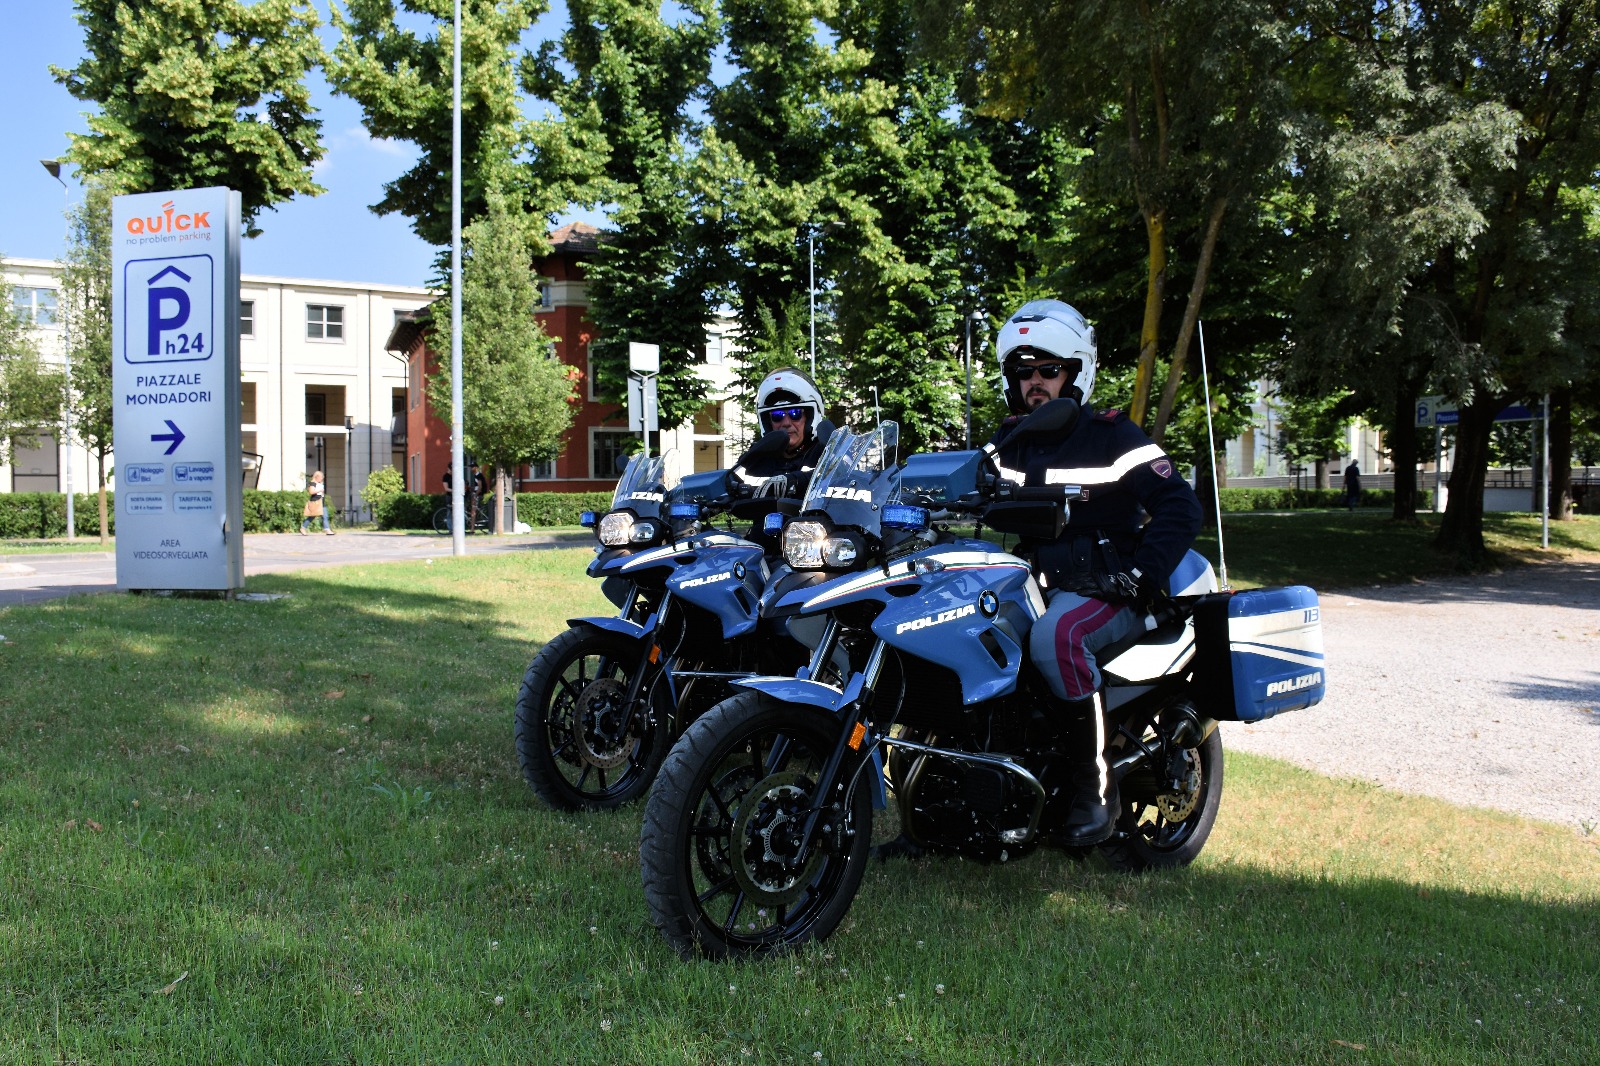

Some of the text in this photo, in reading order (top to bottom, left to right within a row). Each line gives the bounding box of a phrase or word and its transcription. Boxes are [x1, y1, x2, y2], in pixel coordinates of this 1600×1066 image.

[127, 200, 211, 234] QUICK
[140, 234, 176, 246] problem
[179, 232, 211, 243] parking
[147, 286, 191, 356] P
[165, 332, 204, 355] h24
[136, 373, 201, 387] PIAZZALE
[126, 391, 211, 405] MONDADORI
[188, 466, 214, 474] Lavaggio
[160, 539, 181, 548] AREA
[133, 551, 209, 560] VIDEOSORVEGLIATA
[679, 571, 731, 590] POLIZIA
[896, 604, 976, 635] POLIZIA
[1303, 608, 1319, 624] 113
[1266, 671, 1322, 697] POLIZIA
